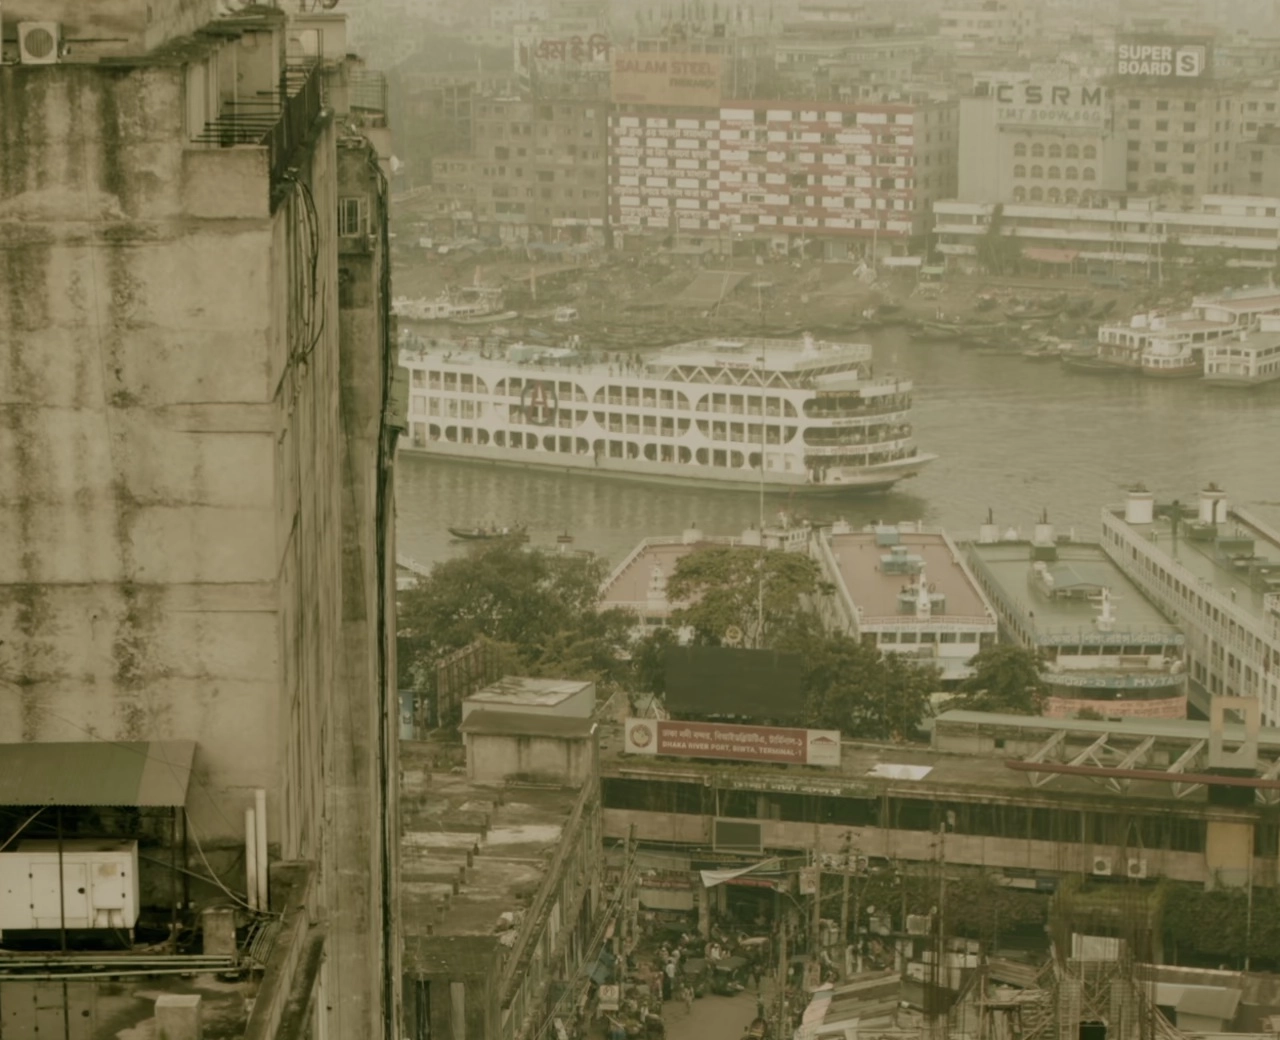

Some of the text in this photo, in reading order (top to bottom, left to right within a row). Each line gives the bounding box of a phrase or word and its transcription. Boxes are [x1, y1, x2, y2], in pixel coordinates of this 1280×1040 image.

[1118, 45, 1173, 61] SUPER
[615, 59, 717, 77] SALAM STEEL
[1118, 61, 1173, 77] BOARD
[996, 84, 1102, 107] CSRM
[662, 741, 687, 750] DHAKA
[688, 742, 710, 750] RIVER
[710, 743, 731, 752] PORT,
